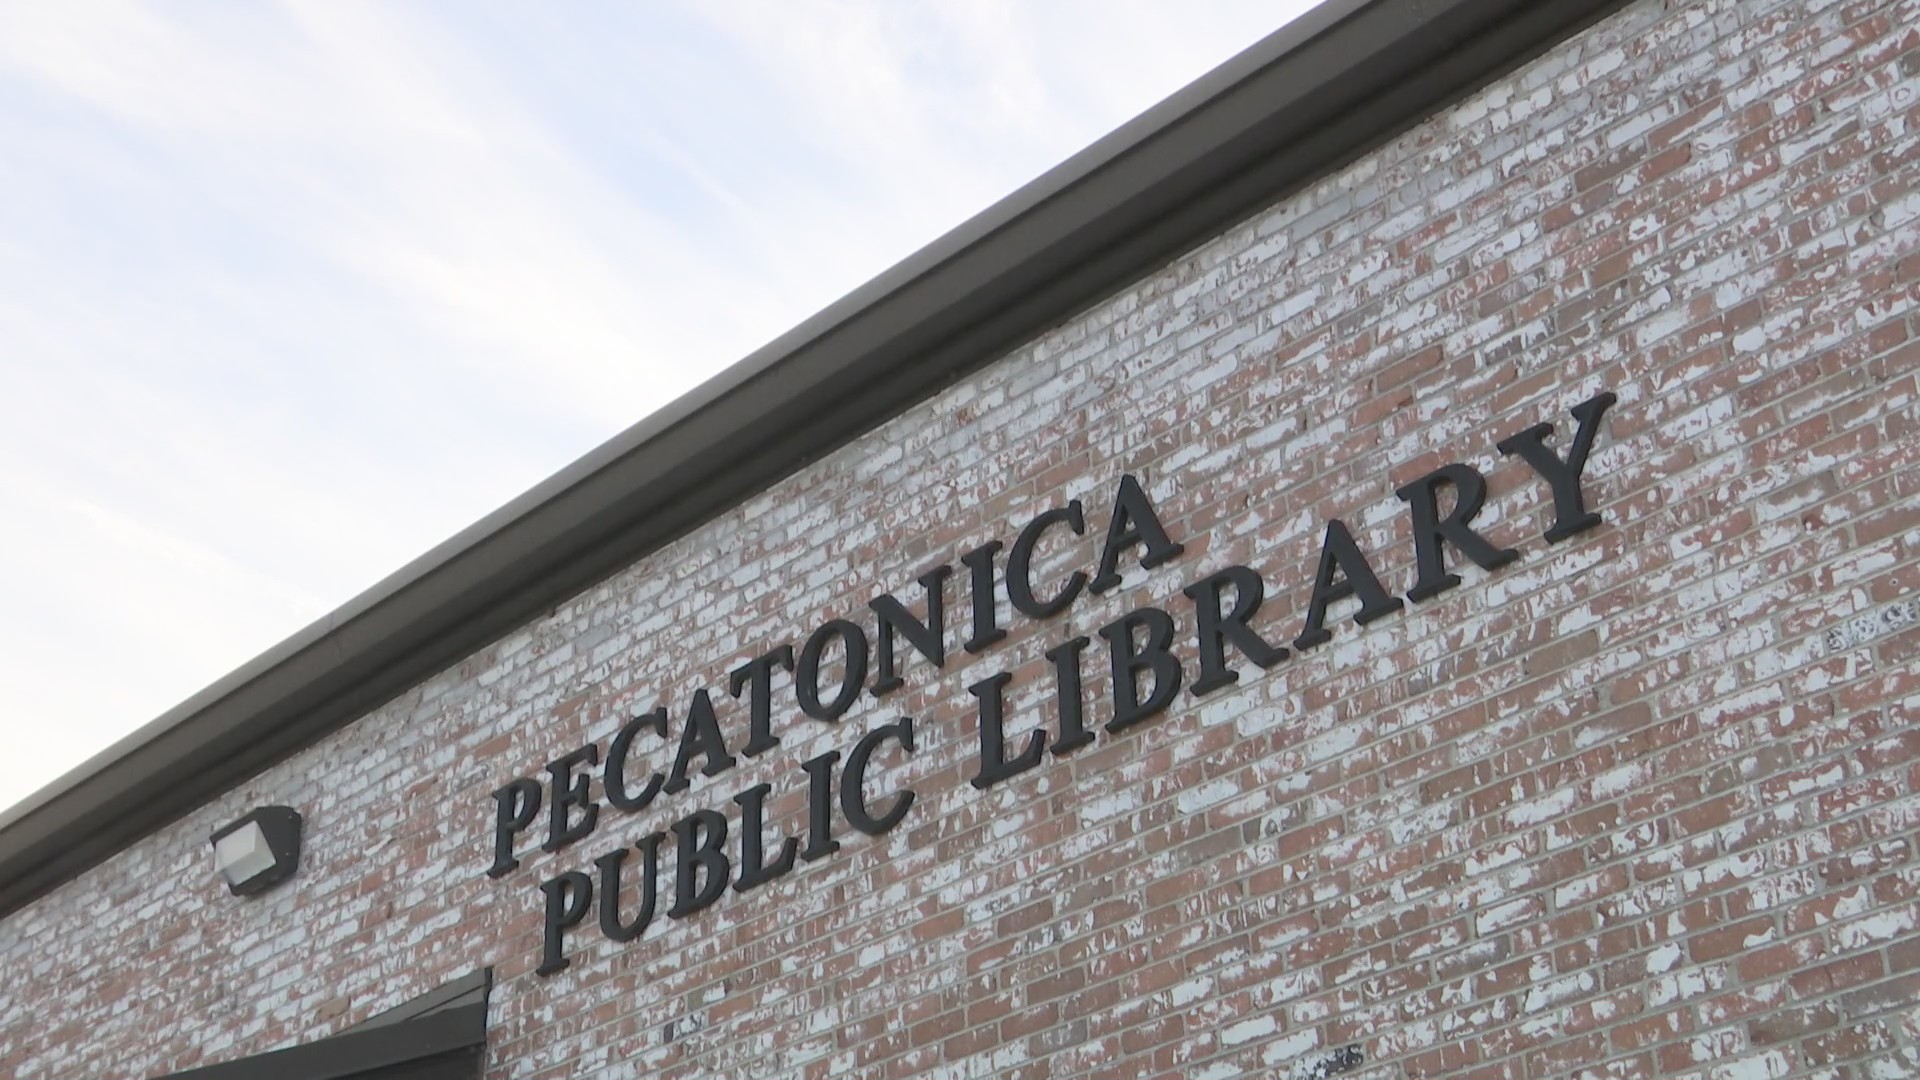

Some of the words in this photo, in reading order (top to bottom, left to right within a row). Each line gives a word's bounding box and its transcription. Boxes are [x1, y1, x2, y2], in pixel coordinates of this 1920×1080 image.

[486, 474, 1185, 880] PECATONICA
[535, 717, 916, 979] PUBLIC
[968, 391, 1617, 791] LIBRARY
